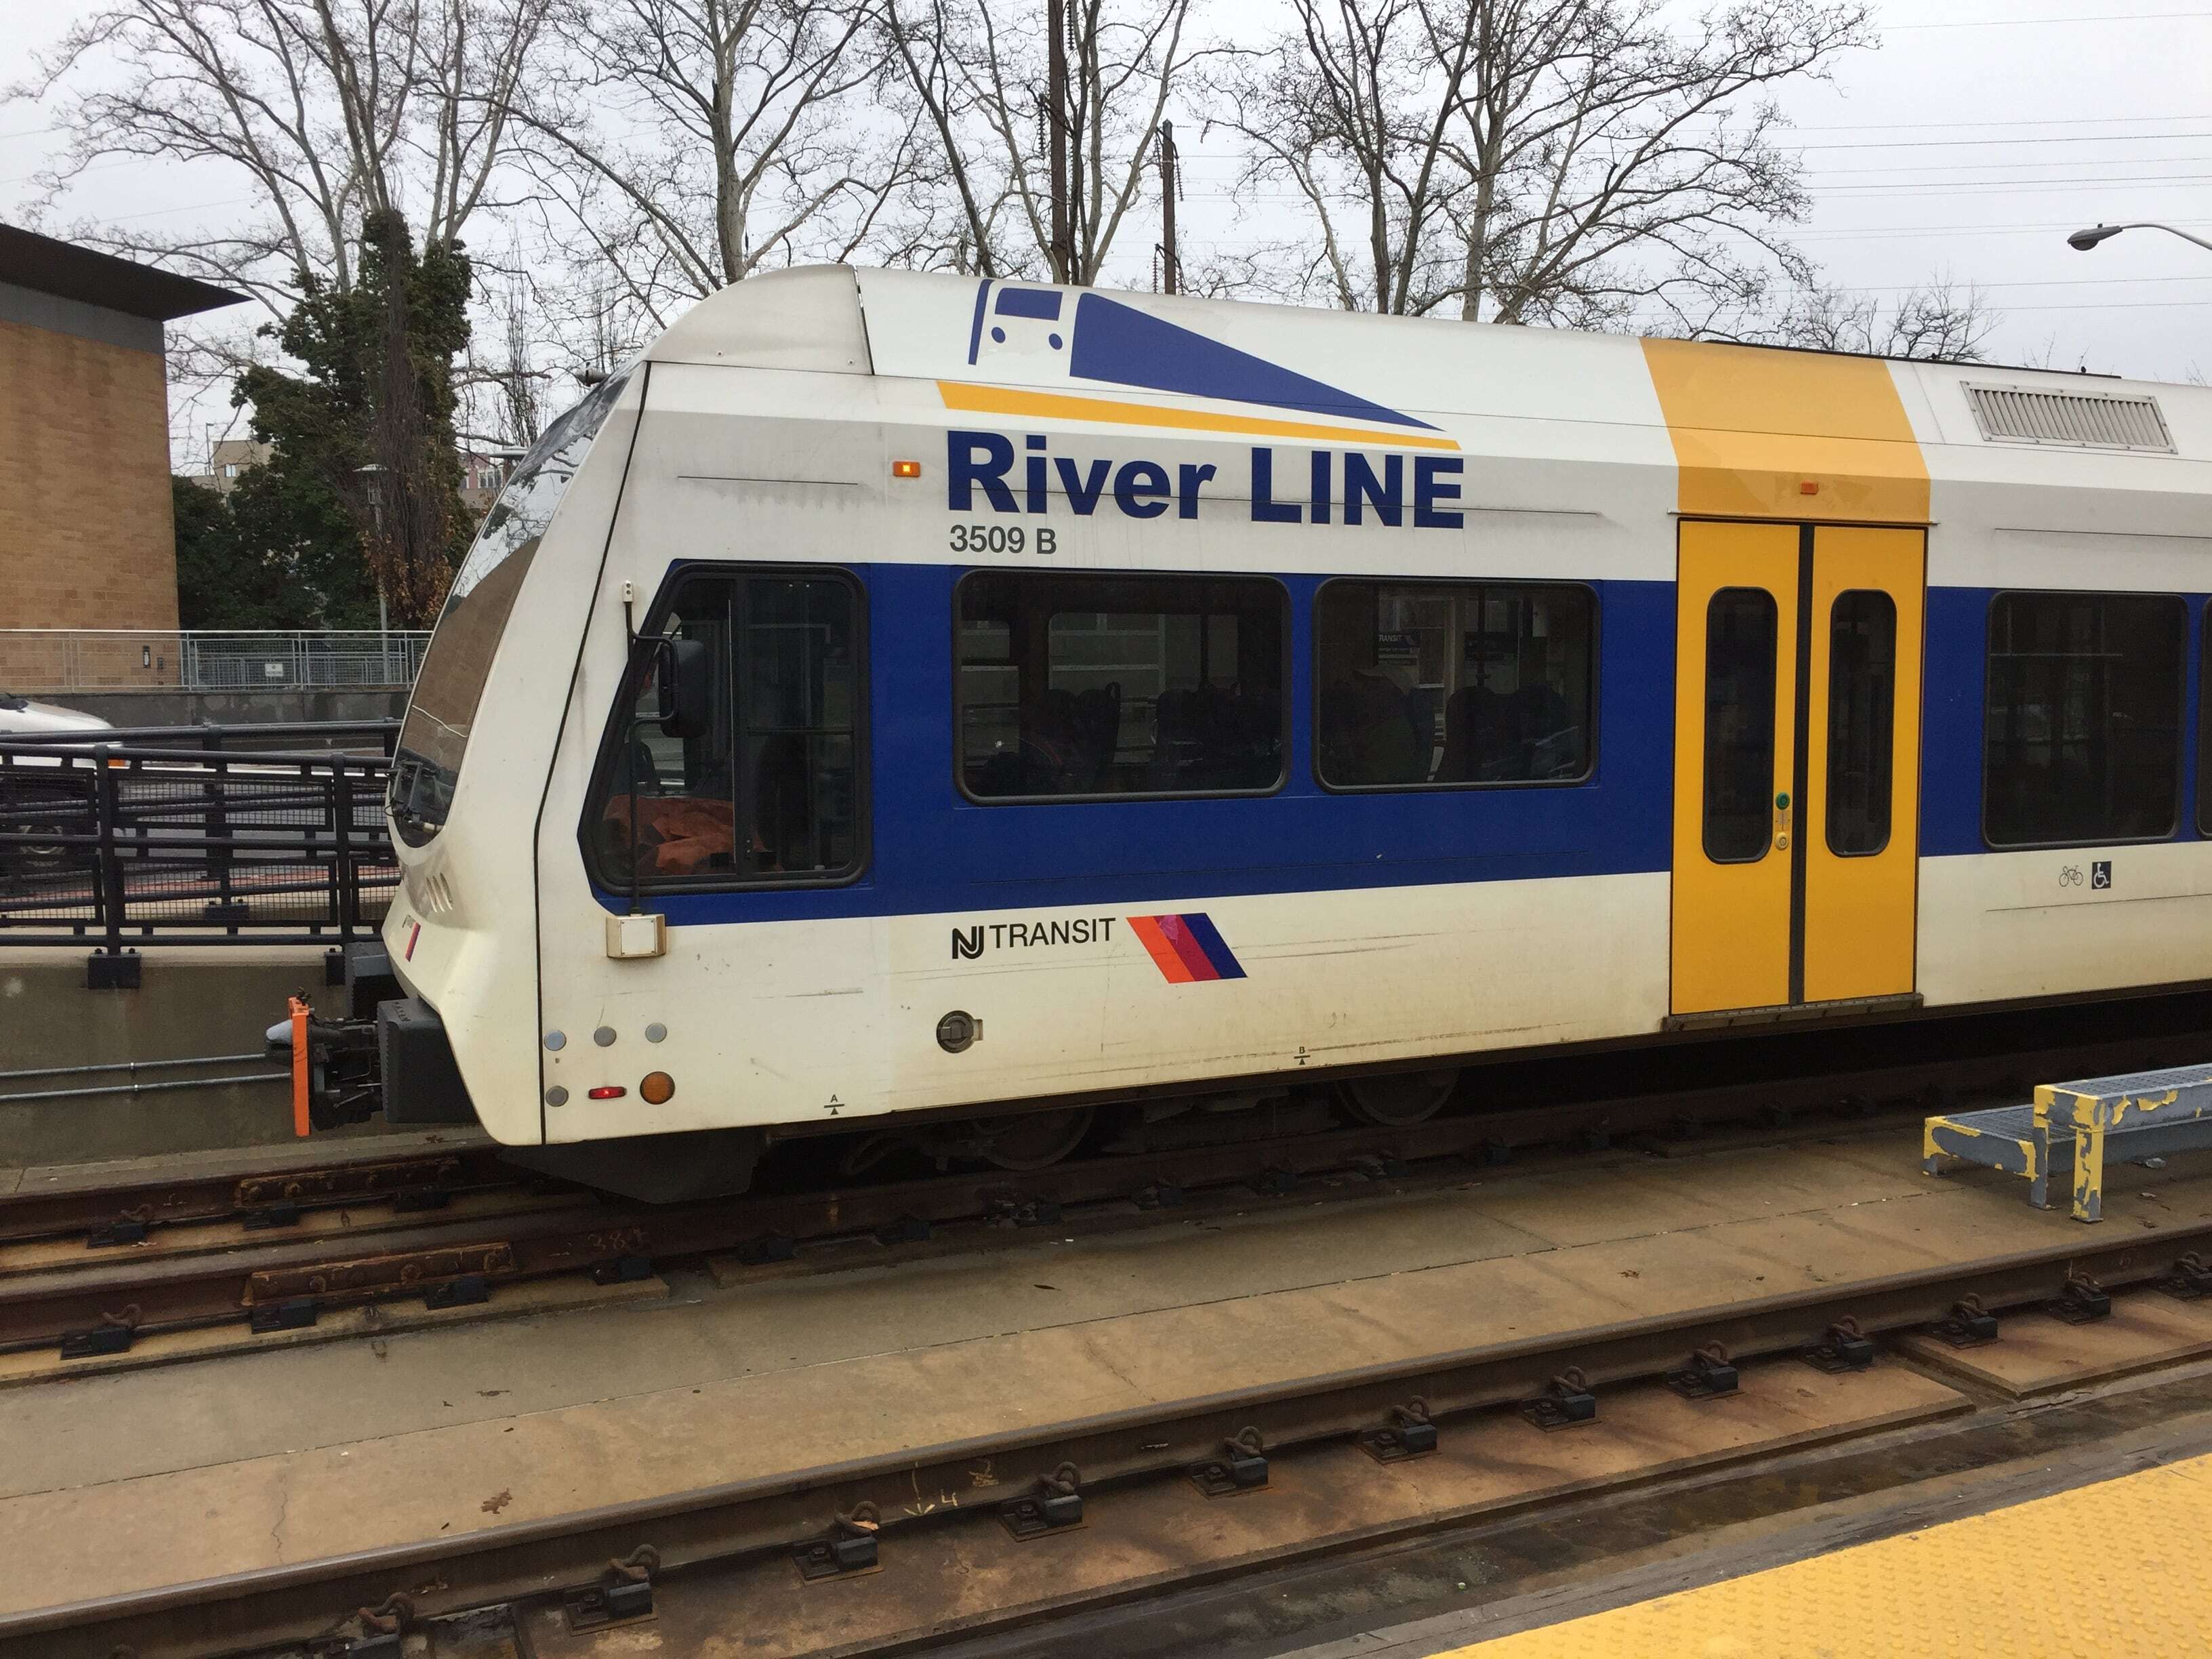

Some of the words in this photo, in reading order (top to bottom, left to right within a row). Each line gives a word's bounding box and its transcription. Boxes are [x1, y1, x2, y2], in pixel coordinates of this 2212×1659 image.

[947, 430, 1217, 520] River
[1251, 447, 1464, 529] LINE
[949, 525, 1025, 554] 3509
[1037, 528, 1057, 554] B
[989, 917, 1116, 949] TRANSIT
[830, 1094, 838, 1103] A
